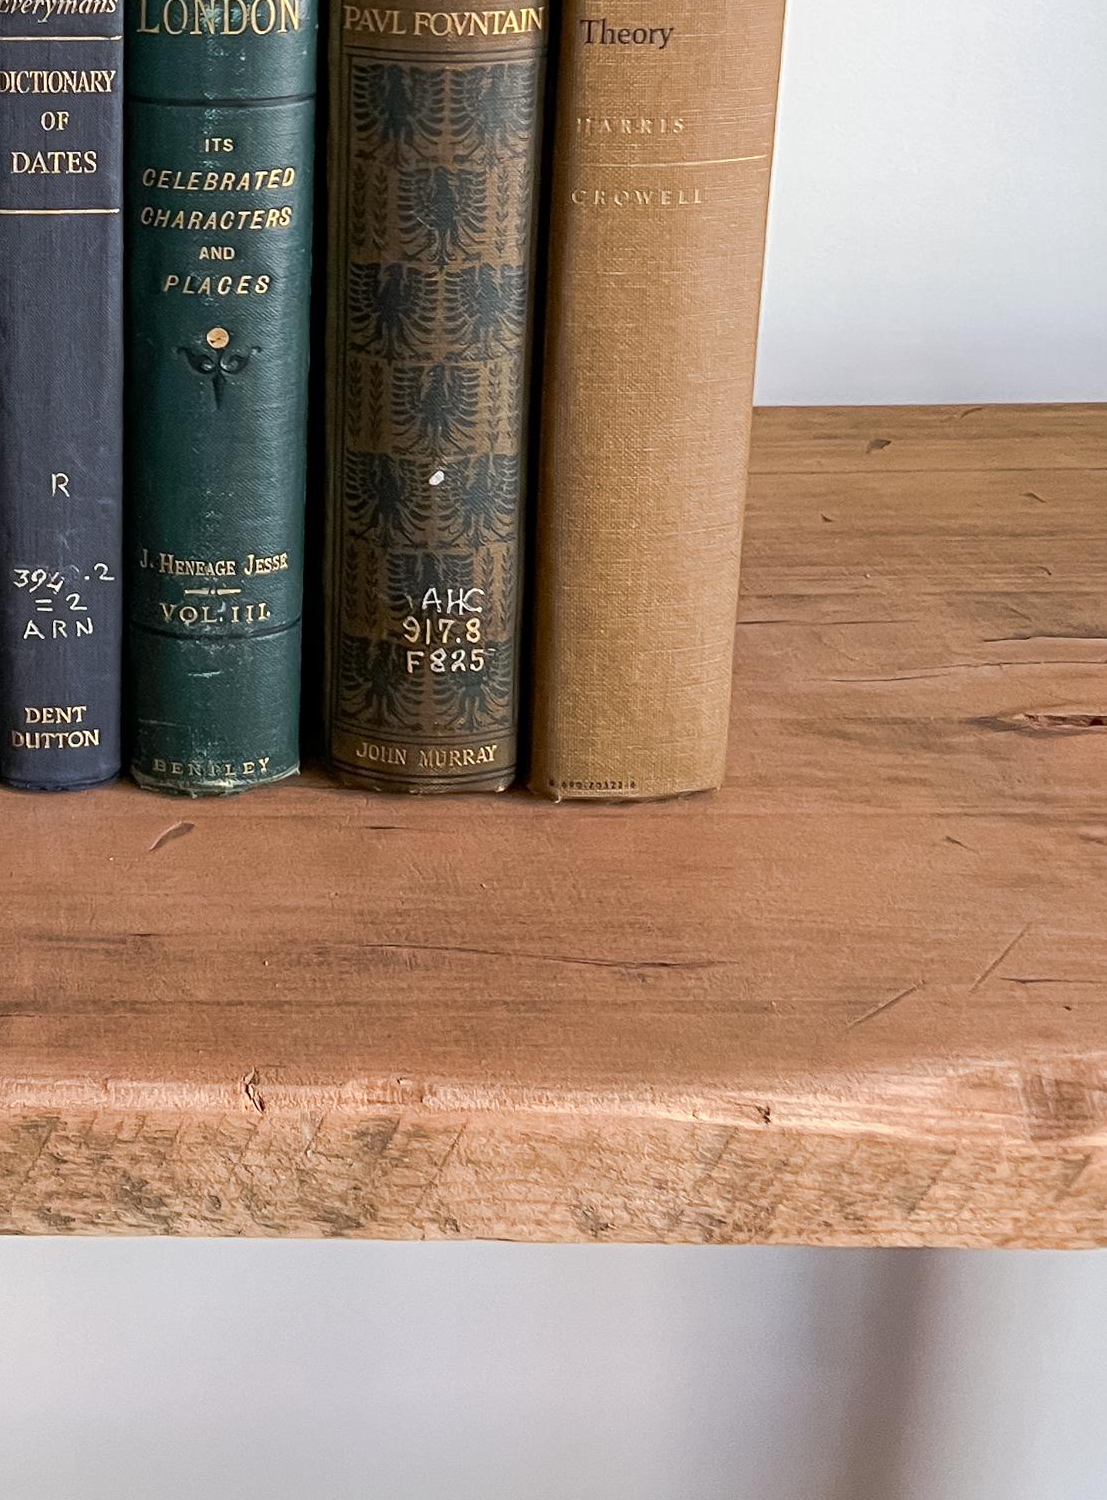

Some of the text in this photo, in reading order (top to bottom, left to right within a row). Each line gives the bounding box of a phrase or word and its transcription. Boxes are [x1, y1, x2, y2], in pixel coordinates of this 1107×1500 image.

[343, 5, 546, 37] PAVL FOVNTAIN
[580, 18, 674, 50] Theory
[40, 111, 70, 131] OF
[204, 138, 234, 152] ITS
[11, 151, 97, 174] DATES
[142, 167, 295, 191] CELEBRATED
[571, 187, 704, 206] CROWELL
[141, 206, 292, 230] CHARACTERS
[199, 246, 235, 260] AND
[162, 274, 271, 295] PLACES
[51, 472, 70, 497] R
[422, 587, 485, 616] AHC
[403, 615, 481, 645] 917.8
[406, 647, 485, 674] F825
[25, 705, 87, 724] DENT
[12, 729, 100, 749] DUTTON
[356, 742, 497, 767] JOHN MURRAY
